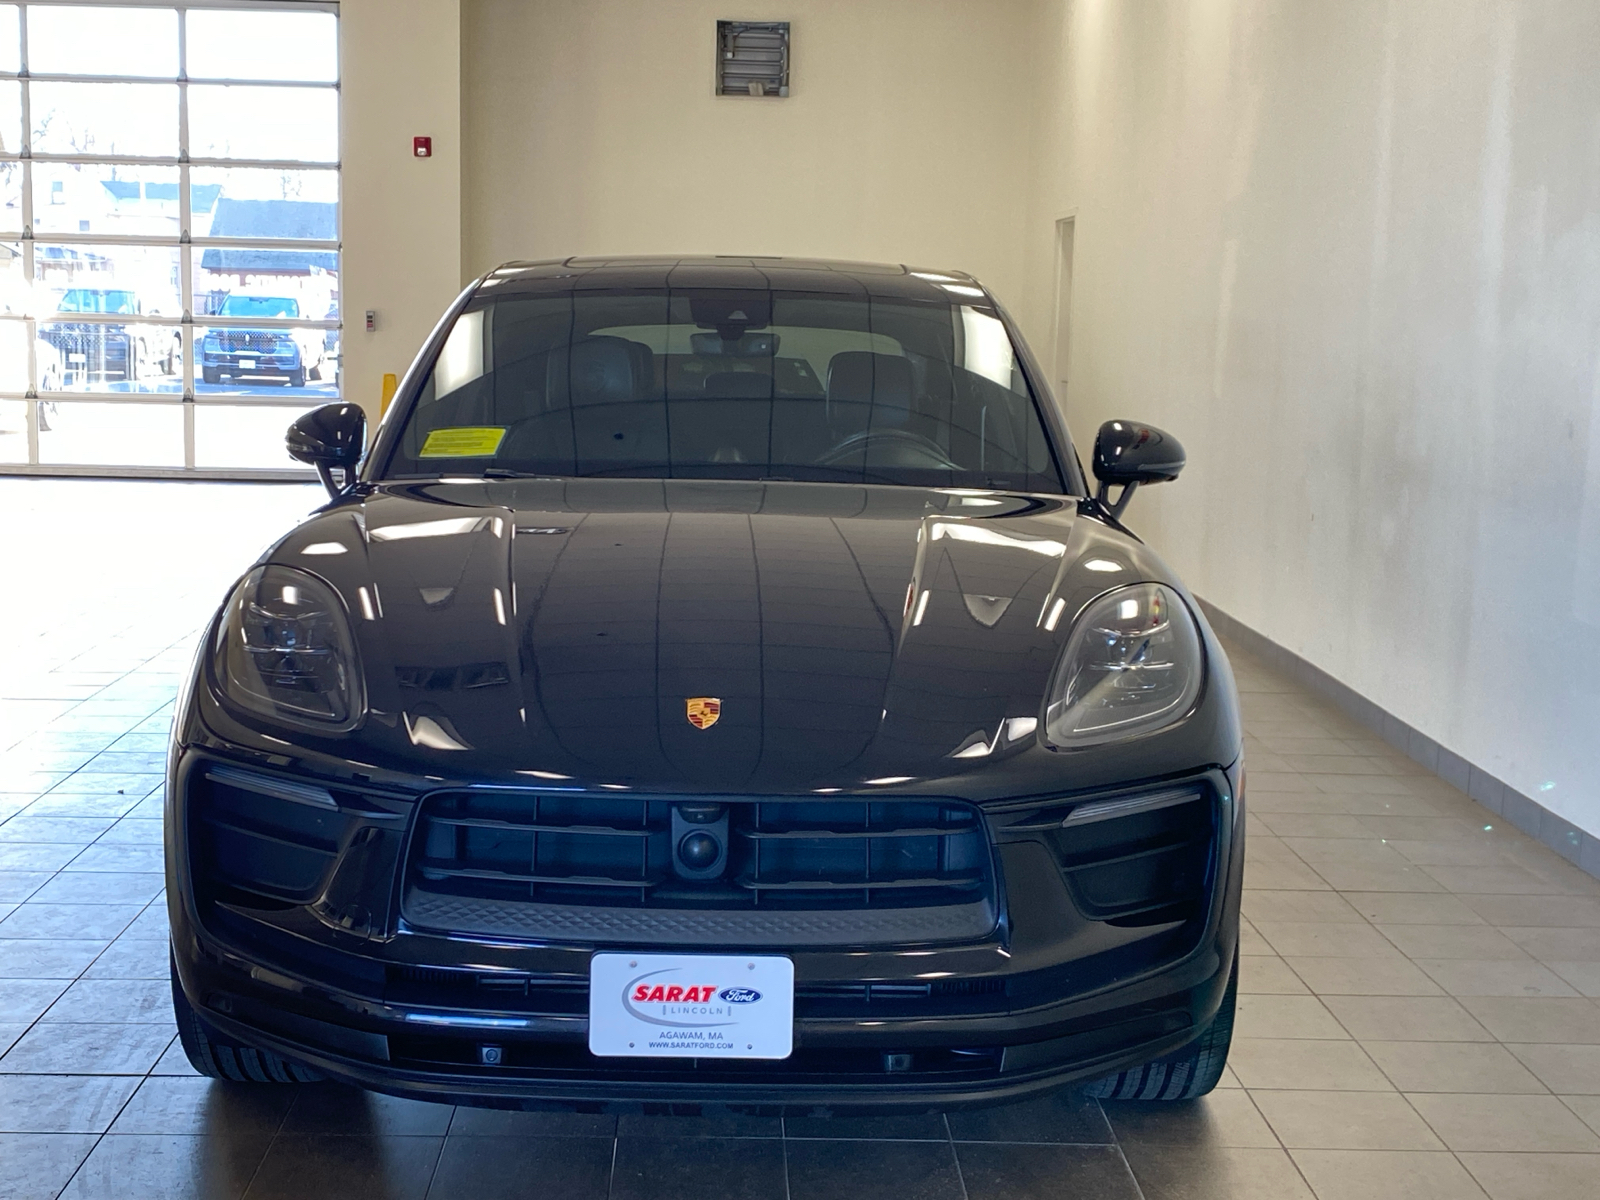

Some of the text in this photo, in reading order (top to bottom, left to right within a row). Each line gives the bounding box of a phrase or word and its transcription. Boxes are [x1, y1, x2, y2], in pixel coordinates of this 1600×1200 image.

[633, 984, 755, 1003] SARAT Ford
[670, 1006, 723, 1015] LINCOLN
[658, 1031, 724, 1041] AGAWAM, MA
[648, 1041, 734, 1050] WWW.SARATFORD.COM
